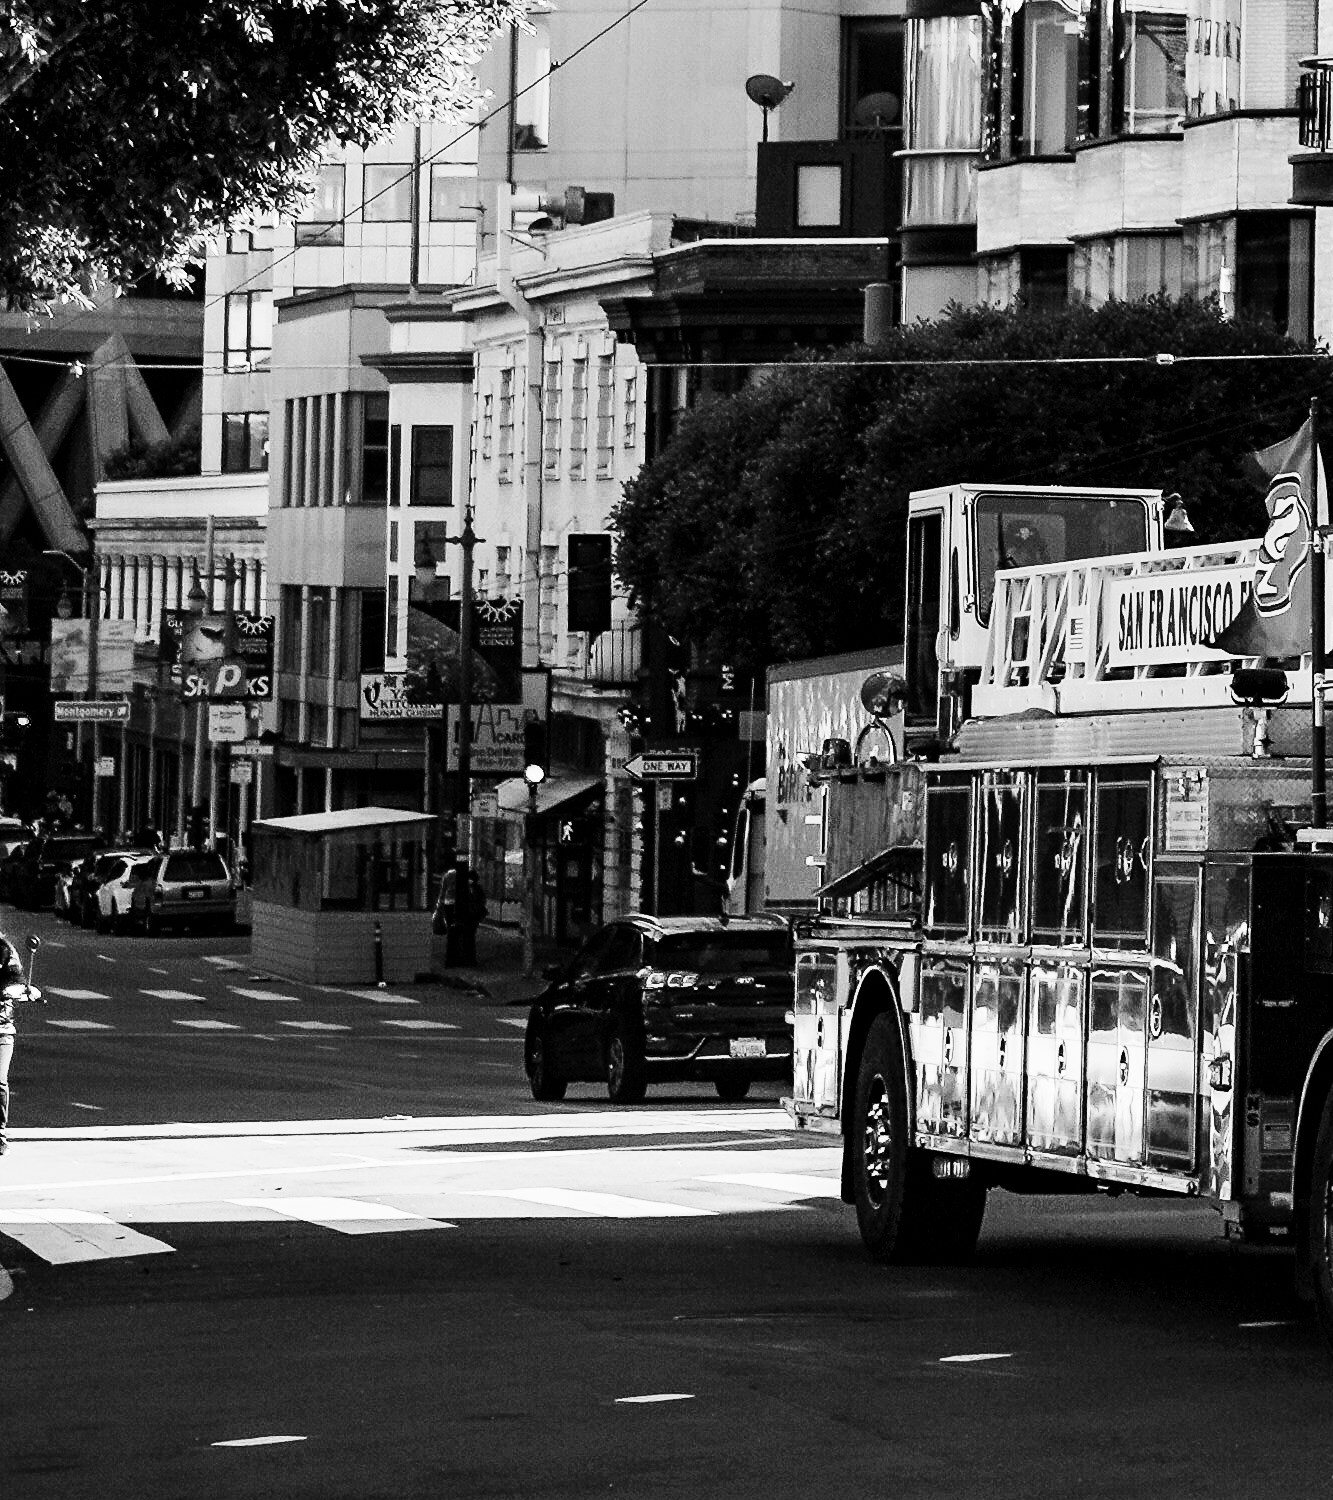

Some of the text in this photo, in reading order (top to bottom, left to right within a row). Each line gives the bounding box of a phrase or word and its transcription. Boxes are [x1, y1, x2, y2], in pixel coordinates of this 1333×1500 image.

[1117, 589, 1145, 652] SAN
[1148, 581, 1234, 649] FRANCISCO
[642, 761, 688, 771] ONE WAY
